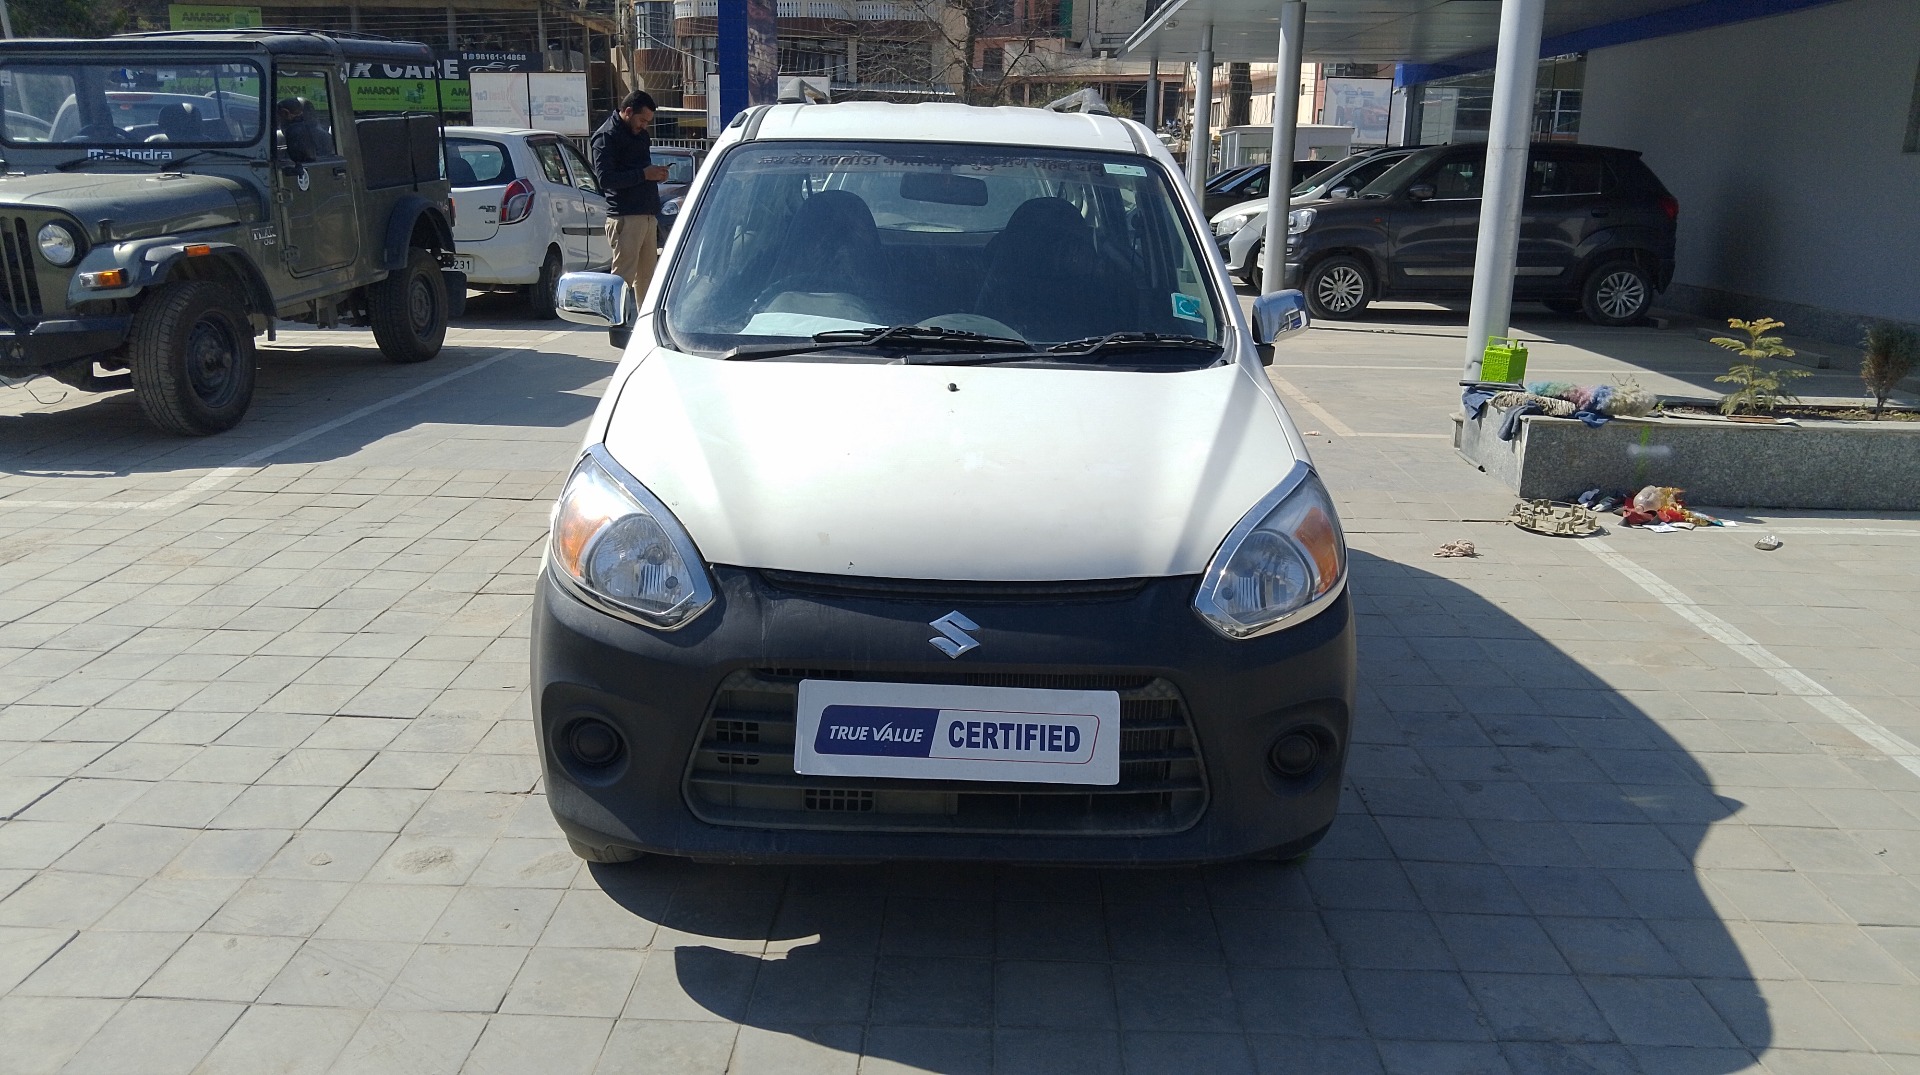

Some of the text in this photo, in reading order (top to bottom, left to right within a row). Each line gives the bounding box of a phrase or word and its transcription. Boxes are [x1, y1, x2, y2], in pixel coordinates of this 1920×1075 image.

[182, 11, 230, 23] AMARON
[383, 59, 460, 79] CARE
[357, 86, 400, 96] AMARON
[829, 720, 1081, 753] TRUE VALUE CERTIFIED
